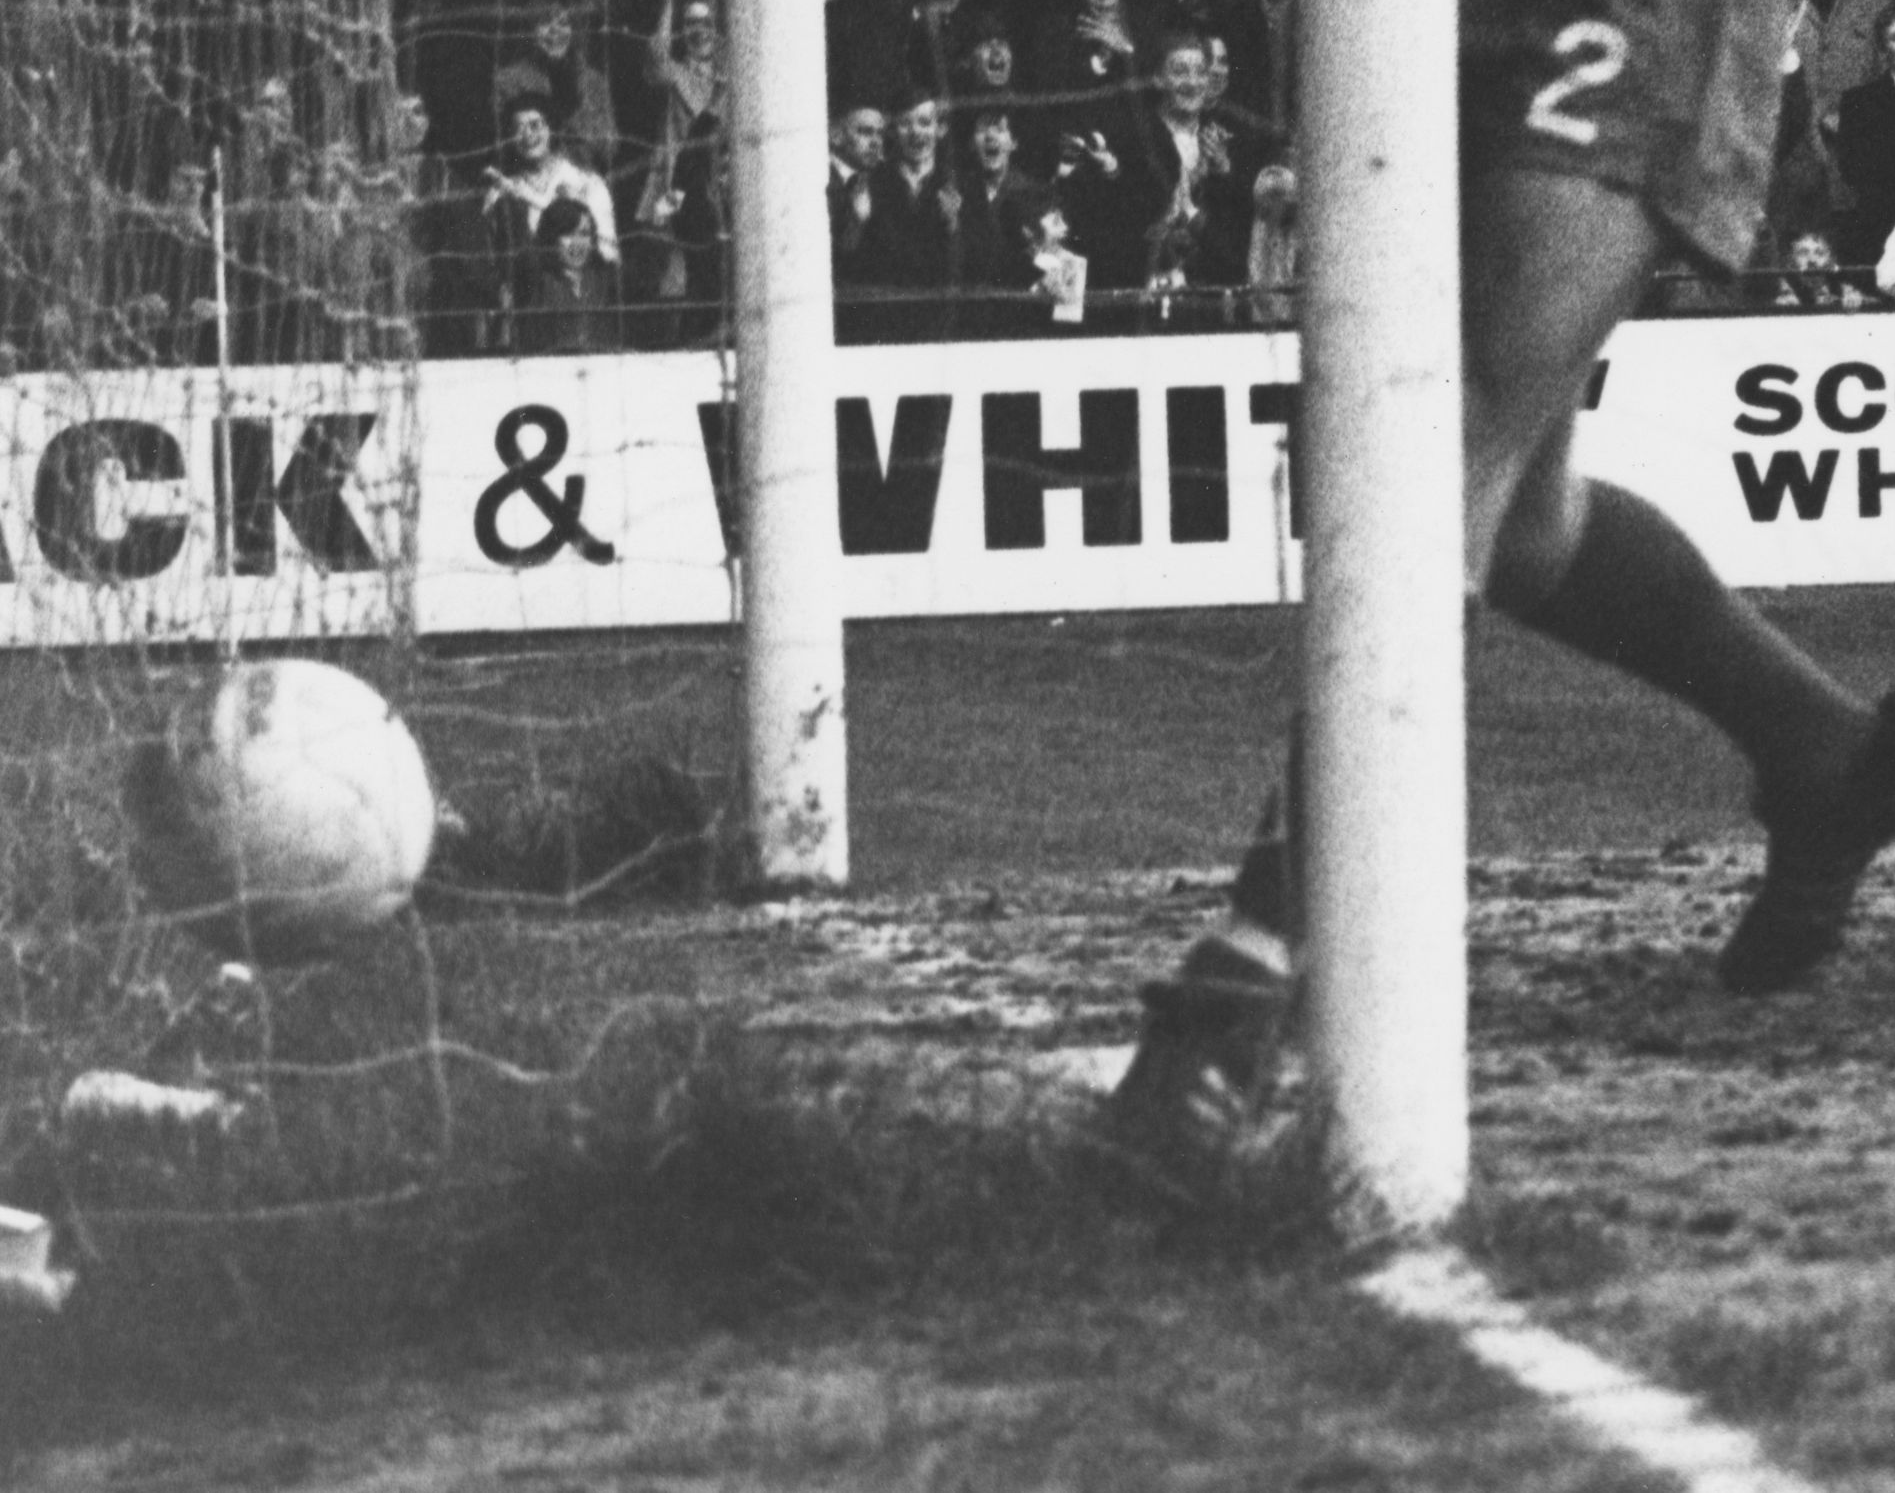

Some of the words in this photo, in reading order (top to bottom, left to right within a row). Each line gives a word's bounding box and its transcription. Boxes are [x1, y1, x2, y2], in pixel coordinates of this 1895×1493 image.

[1527, 20, 1628, 145] 2
[0, 413, 384, 585] CK
[473, 404, 615, 569] &
